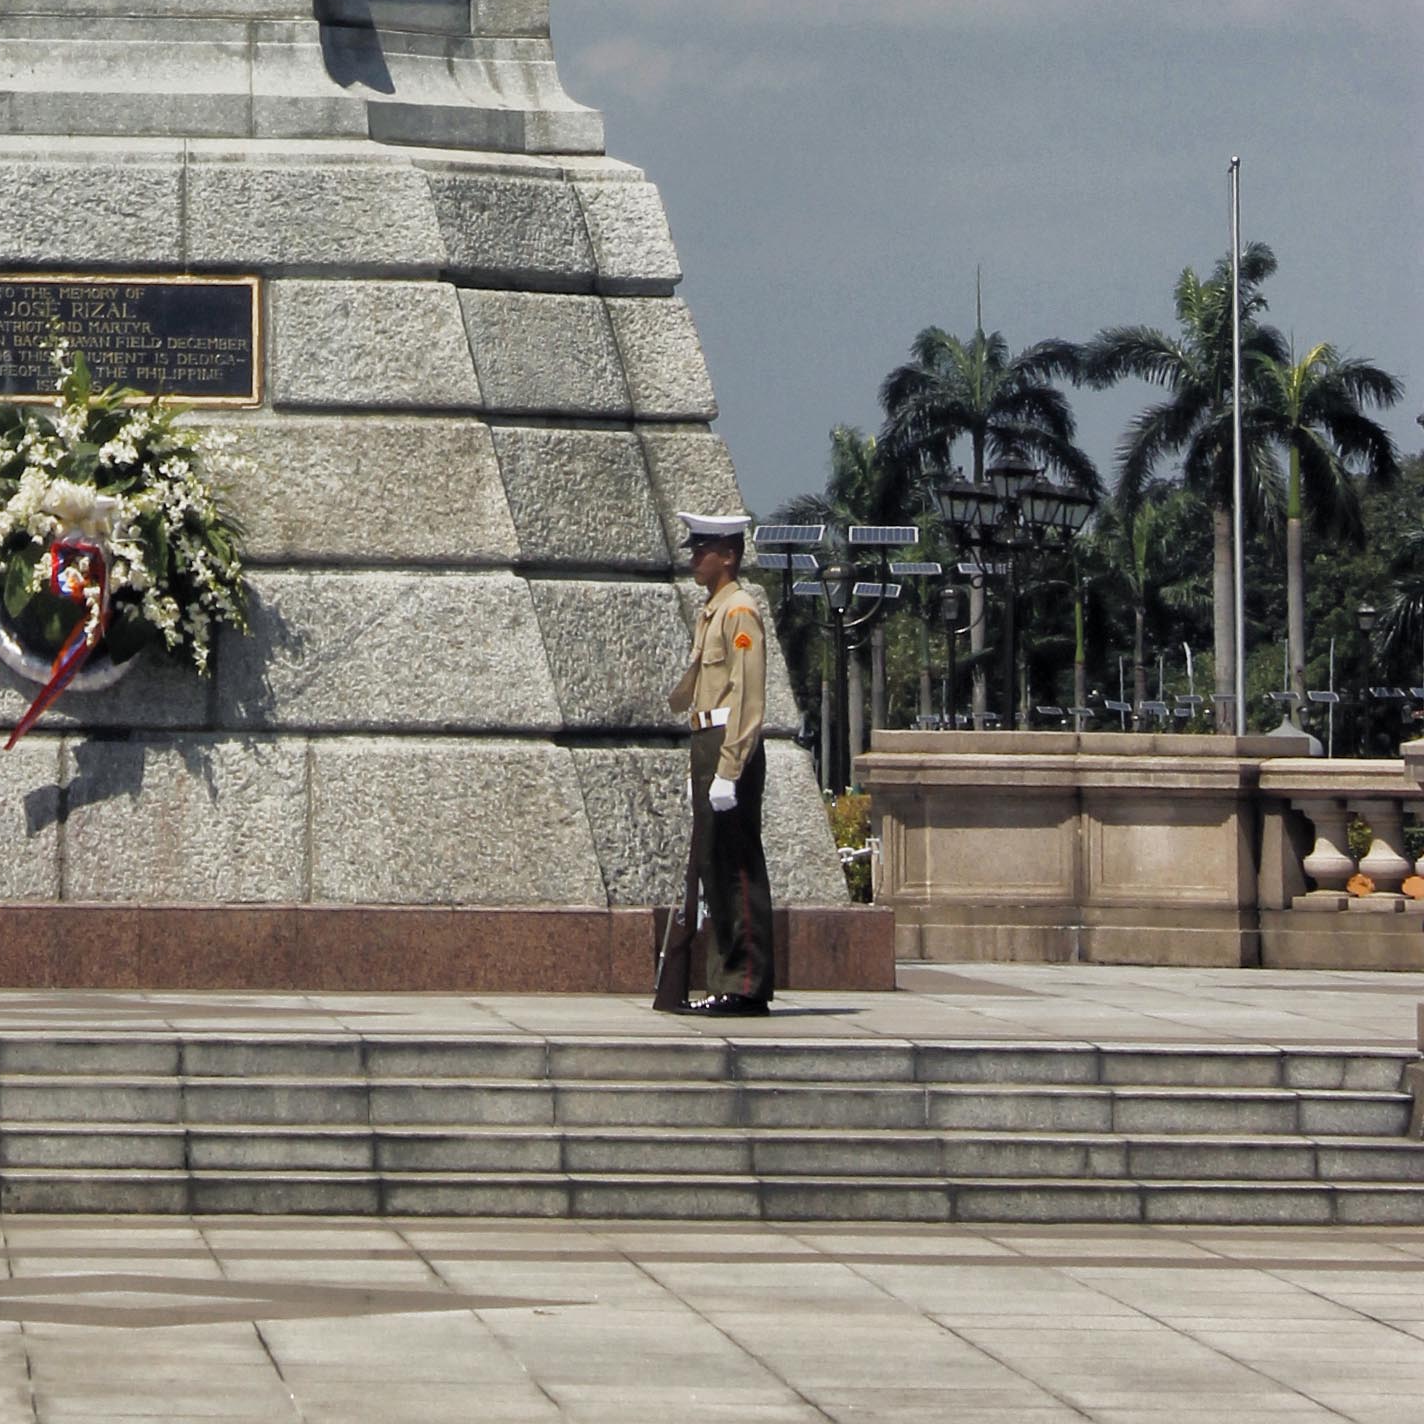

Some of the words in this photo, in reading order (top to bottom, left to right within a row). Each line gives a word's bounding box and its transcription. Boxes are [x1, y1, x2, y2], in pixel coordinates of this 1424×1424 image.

[23, 286, 51, 300] THE
[59, 287, 118, 300] MEMORY
[125, 287, 145, 300] OF
[72, 302, 137, 319] RIZAL
[88, 321, 153, 334] MARTYR
[115, 336, 161, 349] FIELD
[167, 337, 249, 351] DECEMBER
[18, 350, 51, 363] THIS
[155, 352, 169, 365] IS
[96, 367, 128, 379] THE
[136, 368, 224, 381] PHILIPPINE
